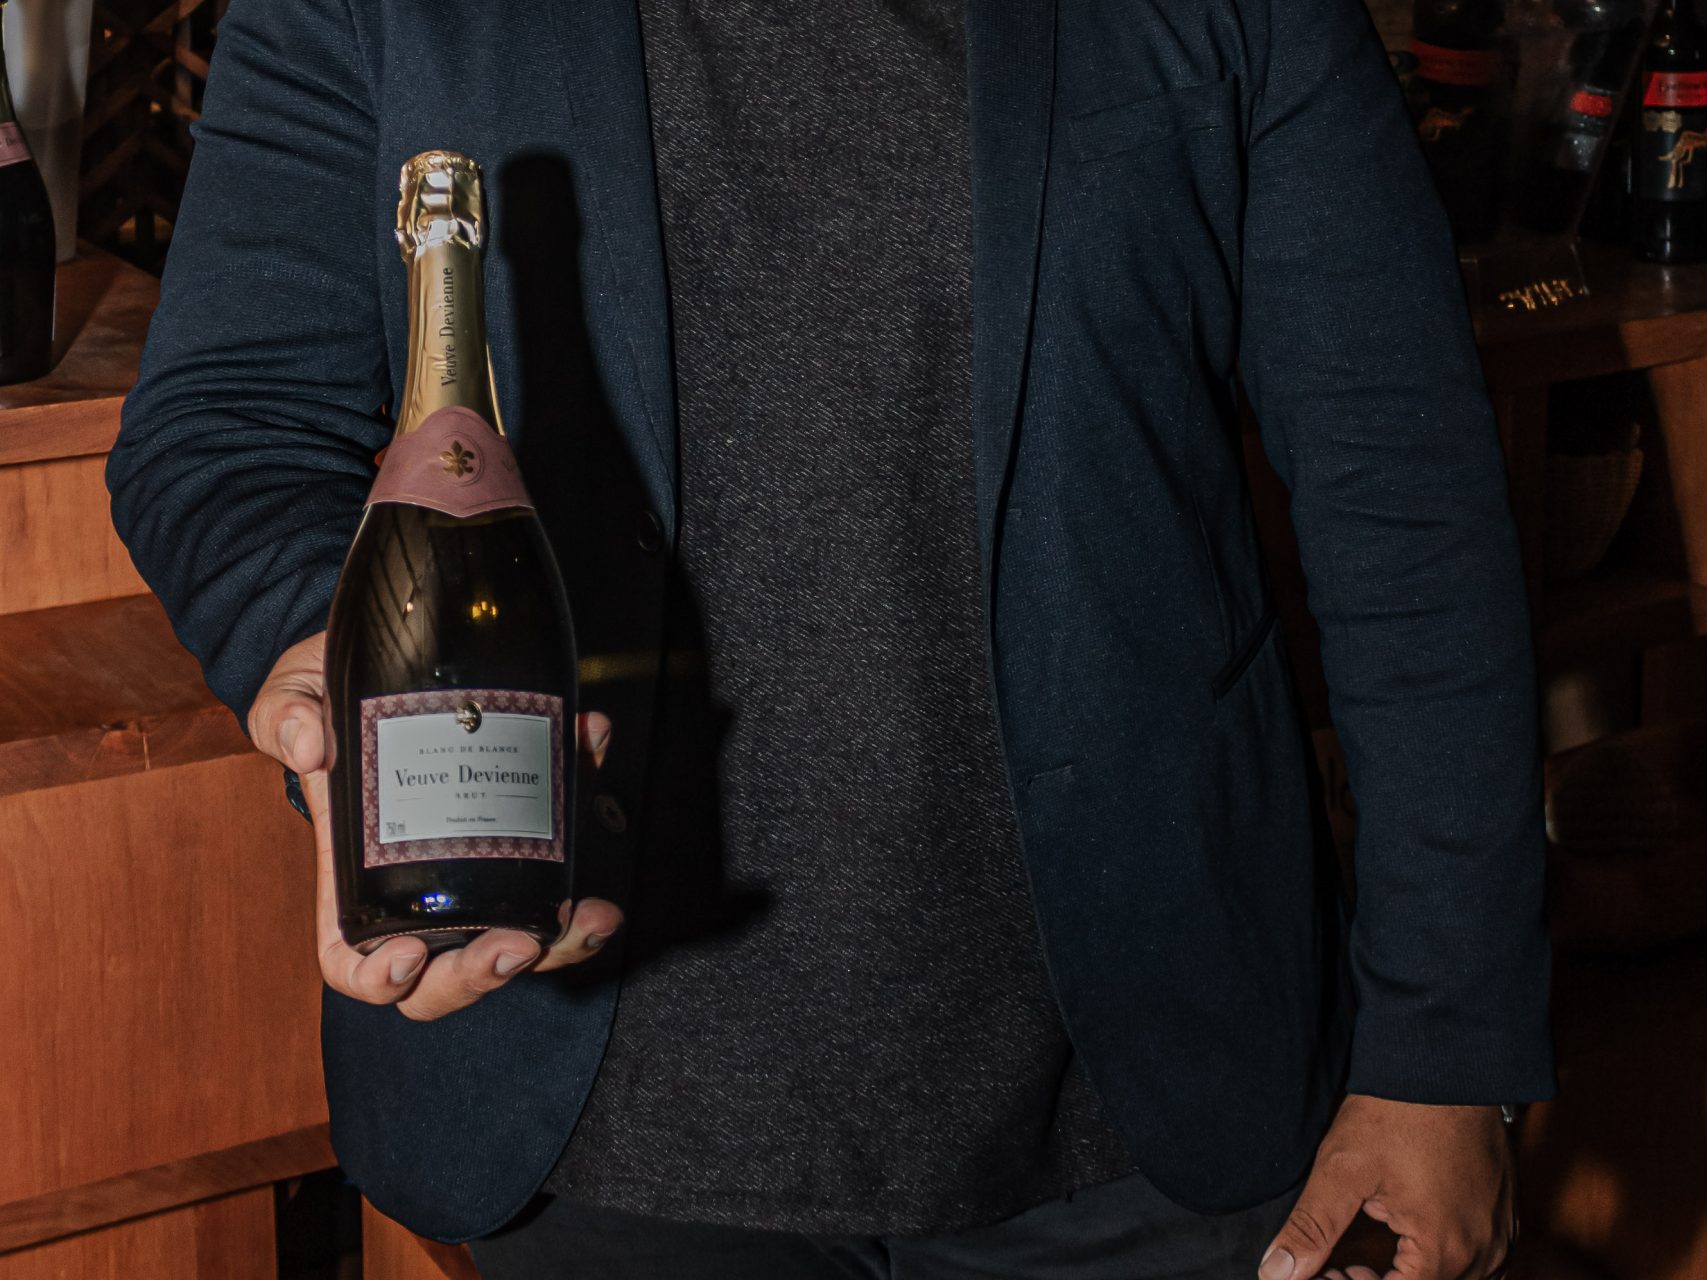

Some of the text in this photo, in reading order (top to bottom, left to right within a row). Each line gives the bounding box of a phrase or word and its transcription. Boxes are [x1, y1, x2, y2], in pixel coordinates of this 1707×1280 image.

[439, 267, 457, 386] Veuve Devienne
[419, 746, 455, 755] BLANC
[460, 745, 473, 753] DE
[394, 764, 540, 788] Veuve Devienne
[455, 791, 487, 800] BRUT
